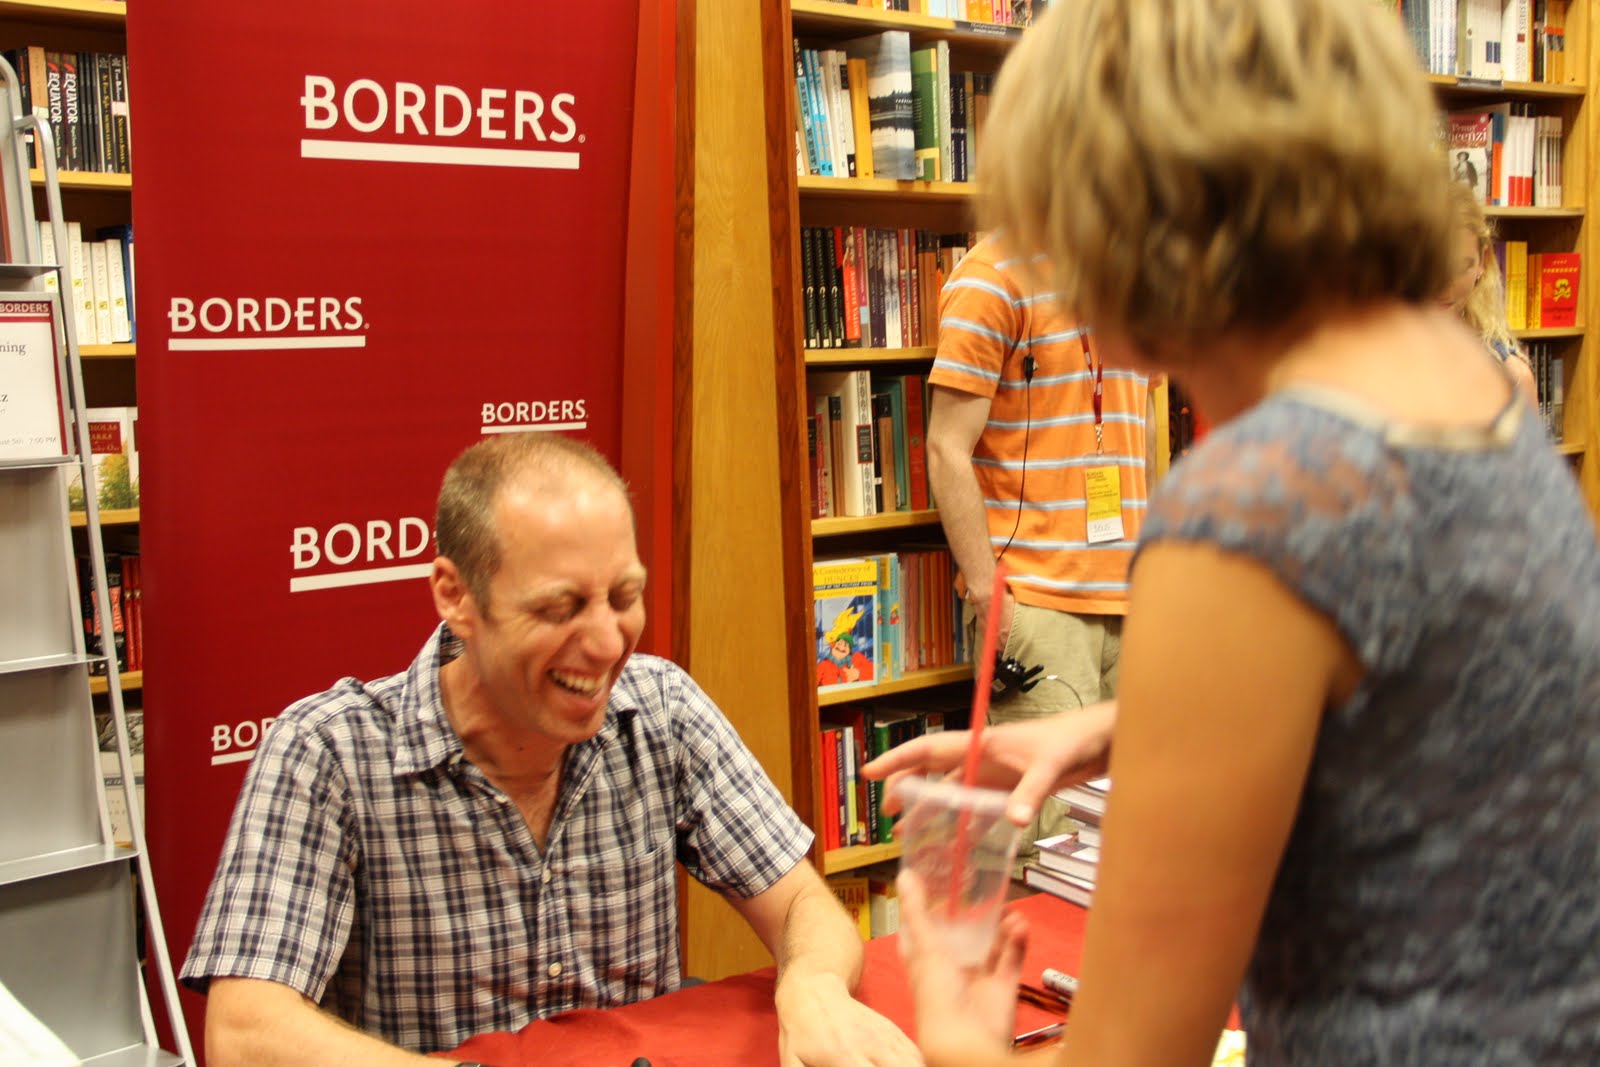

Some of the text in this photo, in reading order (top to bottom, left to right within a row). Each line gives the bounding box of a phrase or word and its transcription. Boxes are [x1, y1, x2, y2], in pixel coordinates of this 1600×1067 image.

[47, 72, 62, 123] EQUATOR
[63, 72, 78, 124] EQUATOR
[300, 75, 578, 143] BORDERS
[0, 303, 49, 313] BORDERS
[168, 297, 364, 333] BORDERS
[0, 341, 26, 356] ning
[481, 399, 586, 424] BORDERS
[290, 517, 437, 570] BORD
